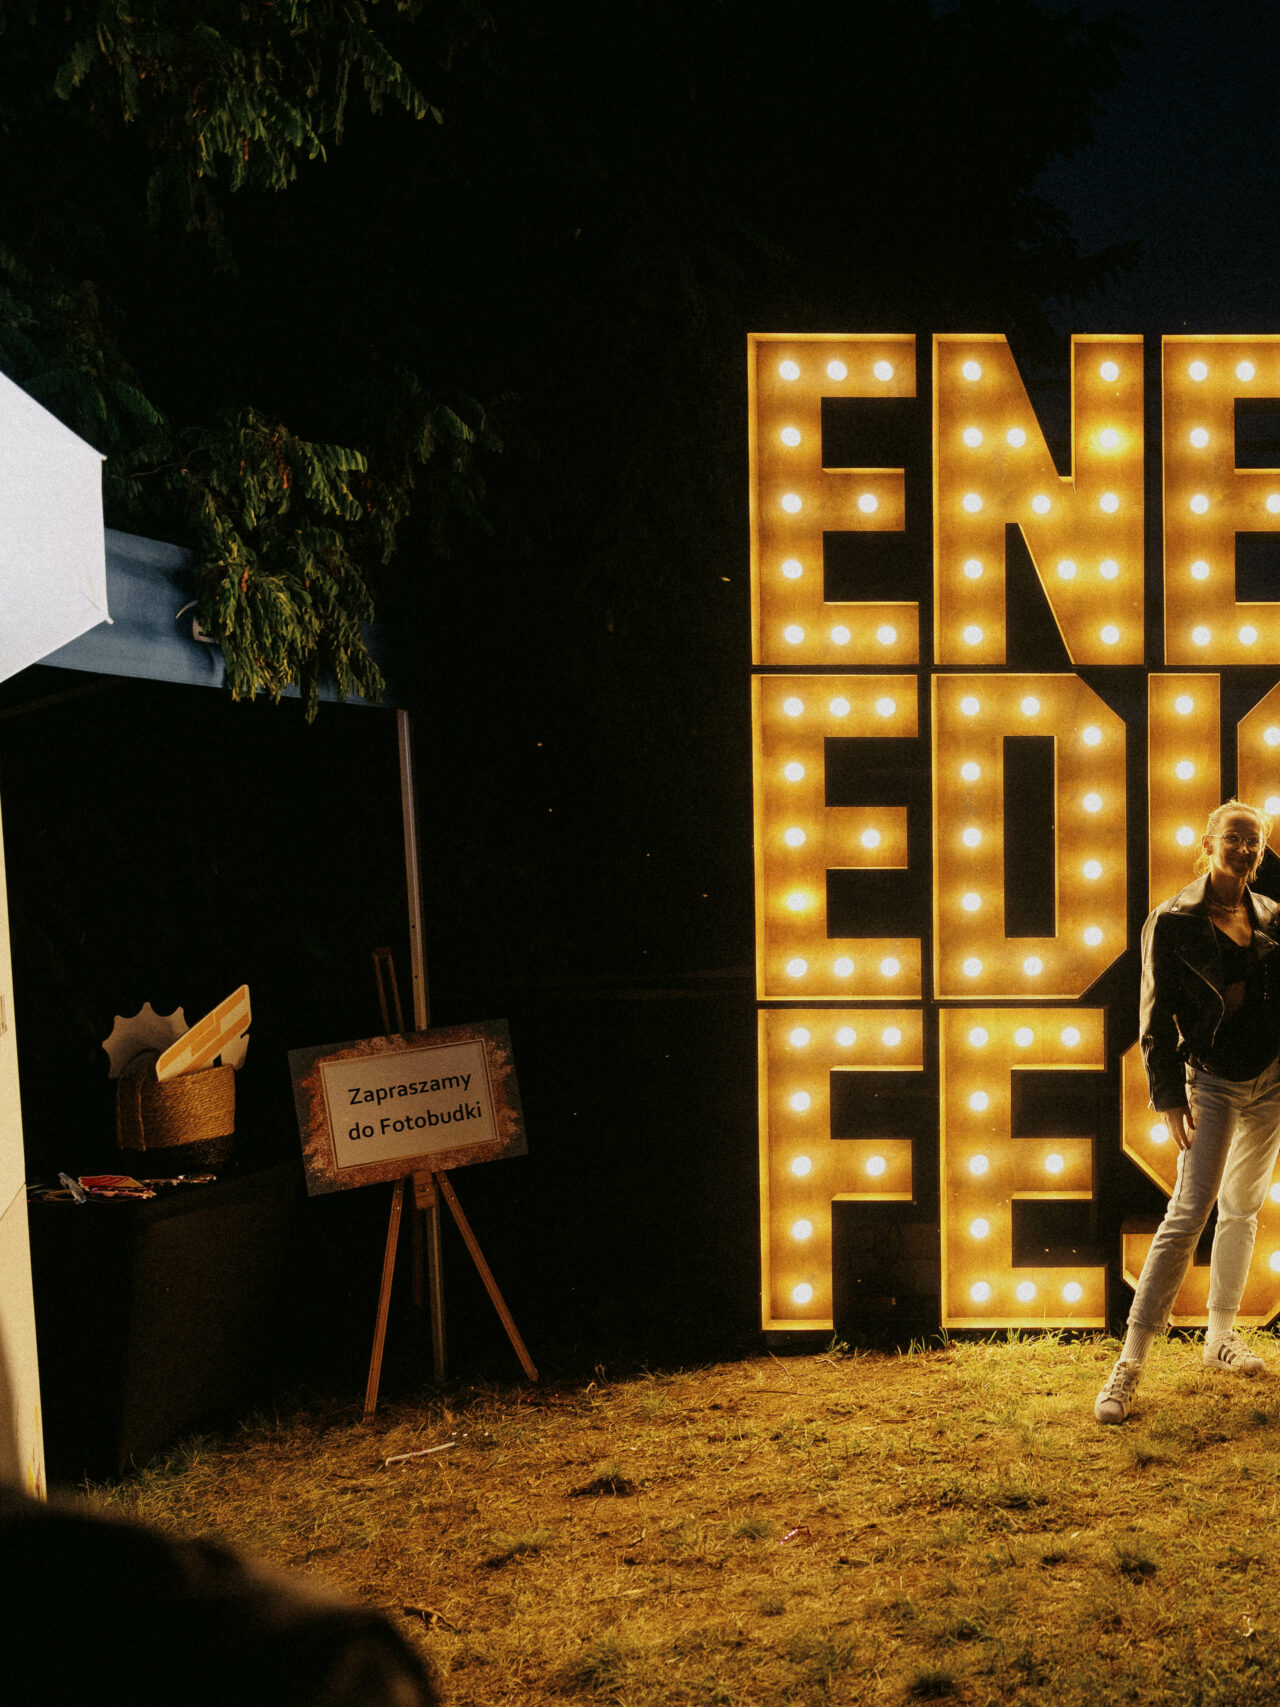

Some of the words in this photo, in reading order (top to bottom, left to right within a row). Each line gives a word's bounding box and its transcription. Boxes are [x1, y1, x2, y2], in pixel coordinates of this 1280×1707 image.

[348, 1073, 472, 1106] Zapraszamy
[348, 1122, 375, 1141] do
[380, 1101, 482, 1135] Fotobudki
